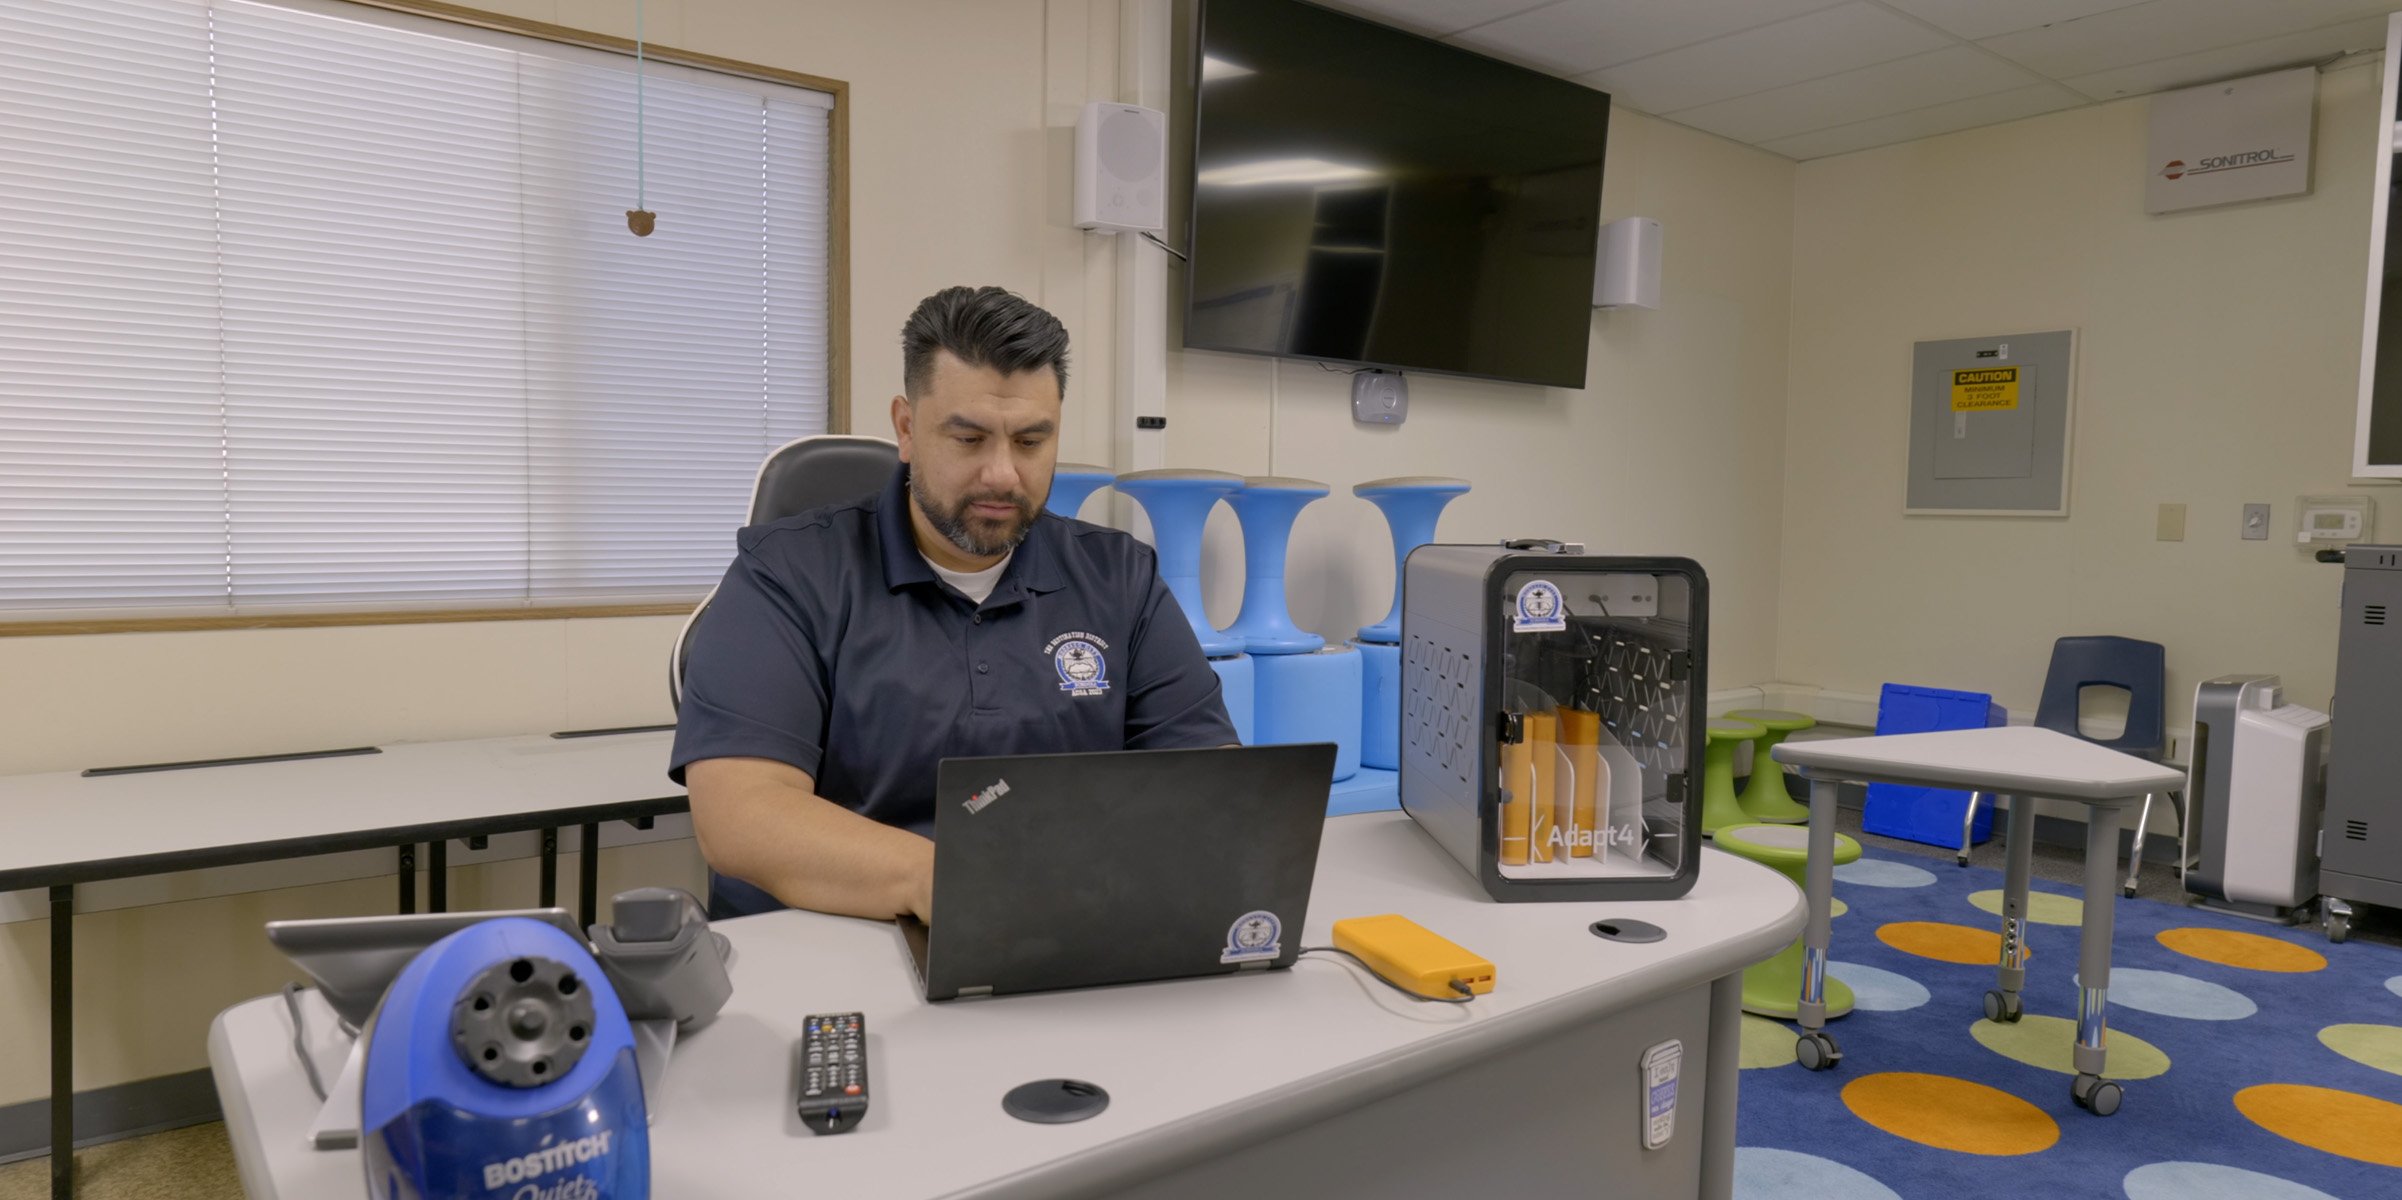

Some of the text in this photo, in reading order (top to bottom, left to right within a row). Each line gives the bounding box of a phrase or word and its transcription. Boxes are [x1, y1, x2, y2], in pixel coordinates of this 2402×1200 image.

[2200, 149, 2279, 170] SONITROL
[1959, 371, 2012, 383] CAUTION
[1964, 385, 2005, 393] MINIMUM
[1976, 392, 2001, 400] FOOT
[1957, 400, 2010, 408] CLEARANCE
[962, 778, 1010, 815] ThinkPad
[1546, 823, 1634, 854] Adapt4
[483, 1133, 610, 1191] BOSTITCH
